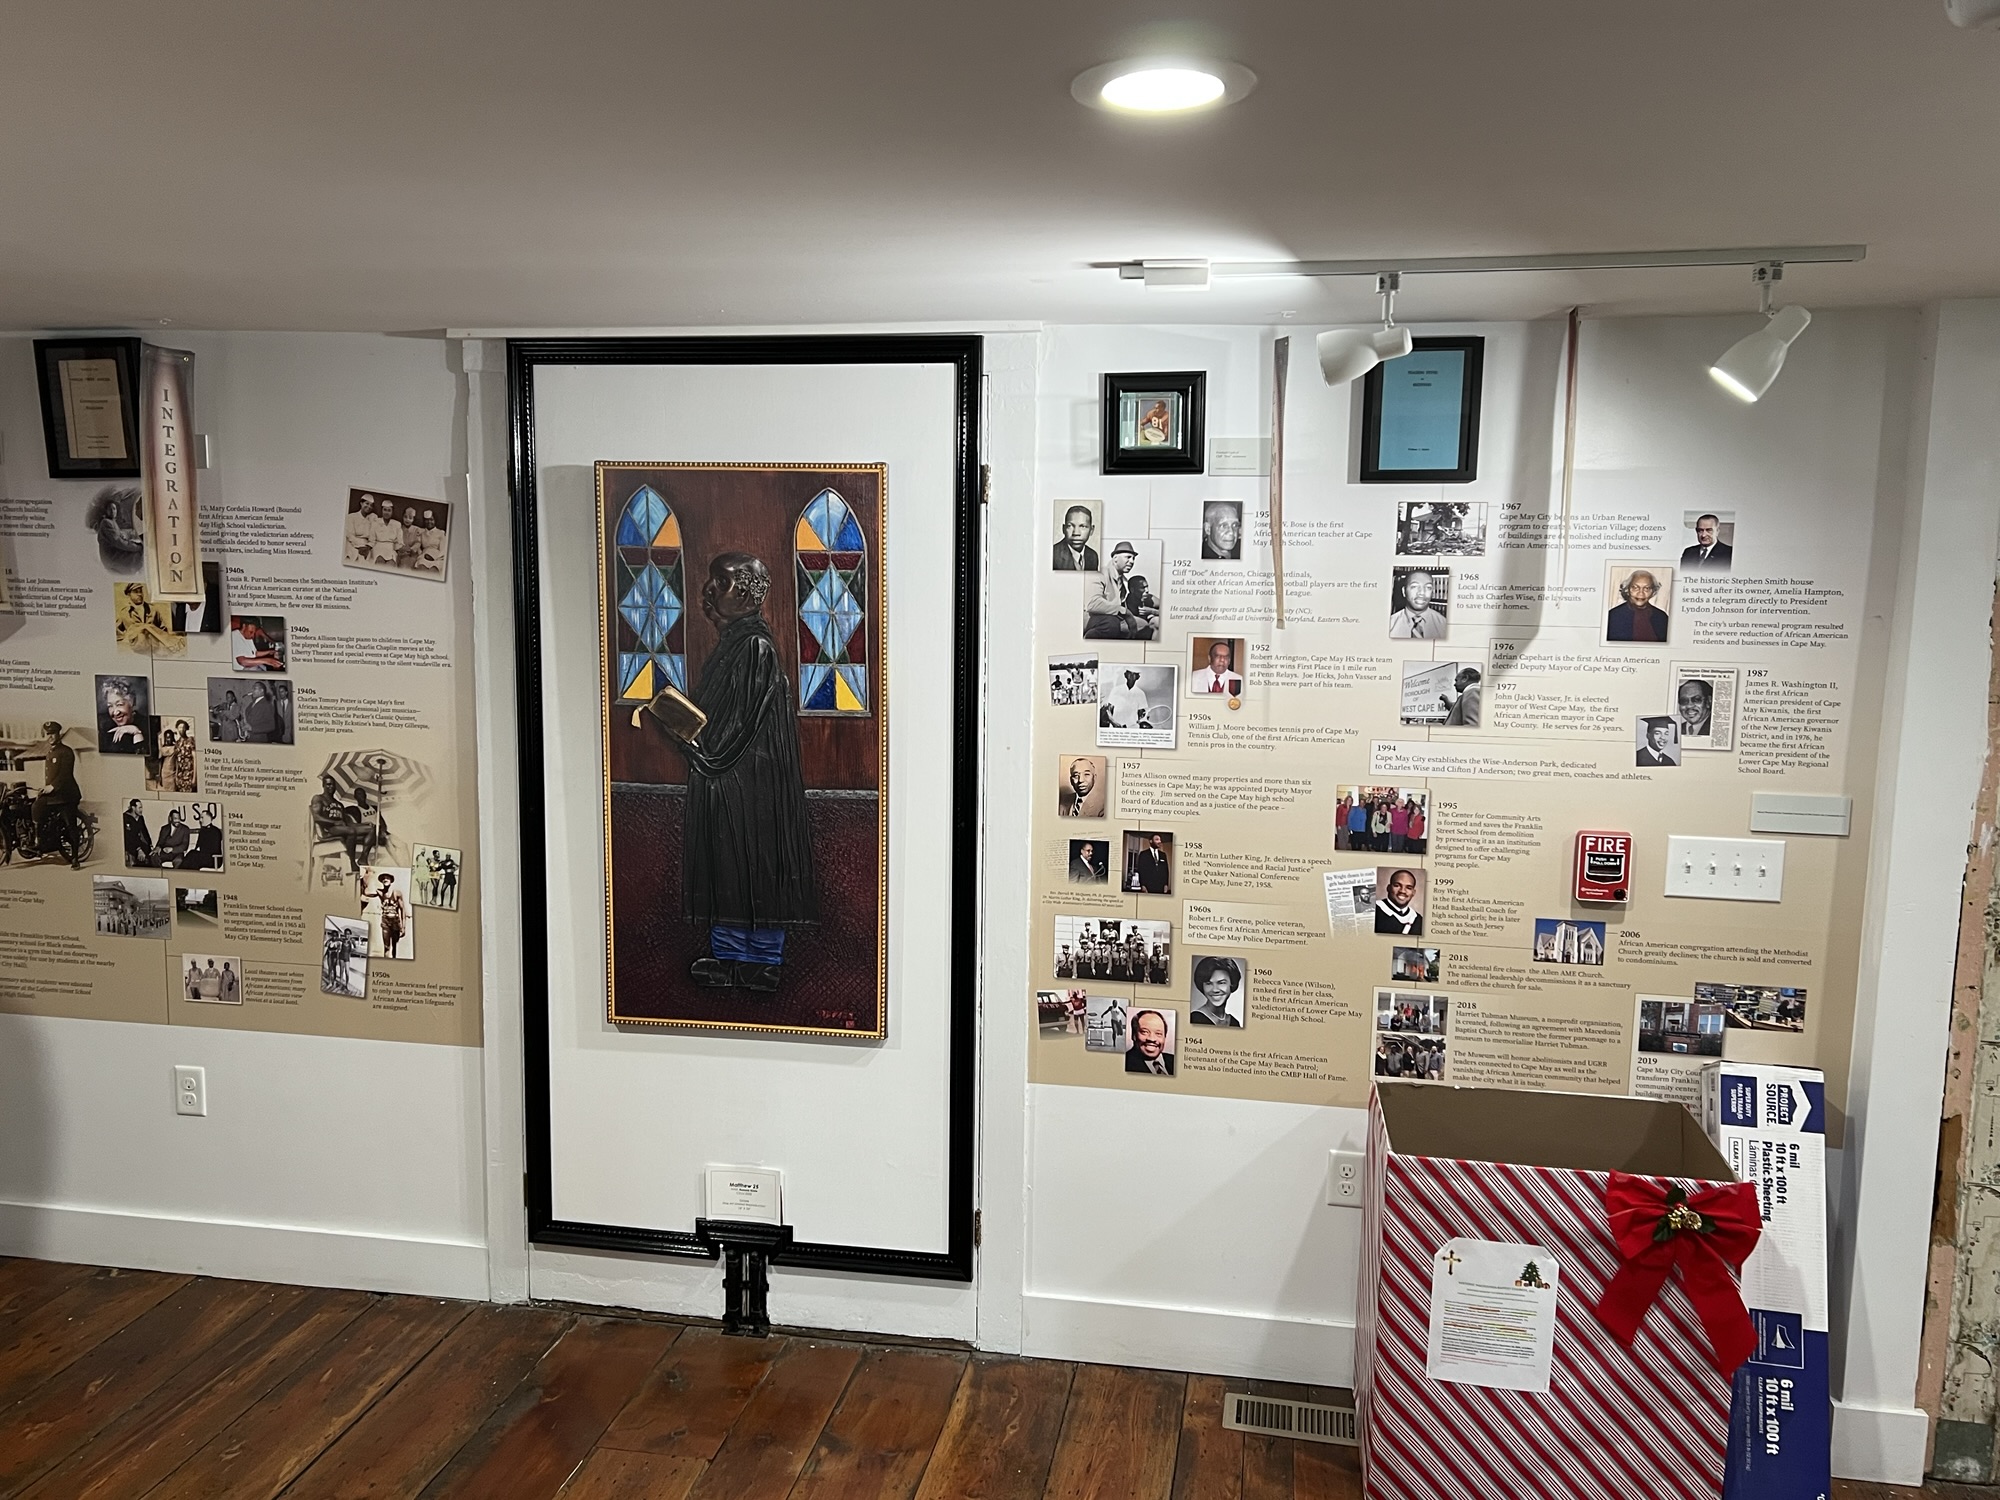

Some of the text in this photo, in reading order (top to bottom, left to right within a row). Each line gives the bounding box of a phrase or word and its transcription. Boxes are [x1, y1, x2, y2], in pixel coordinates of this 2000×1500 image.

[1151, 416, 1163, 430] 81
[161, 388, 184, 583] INTEGRATION
[1502, 502, 1522, 510] 1967
[1173, 559, 1191, 567] 1952
[225, 566, 244, 574] 1940s
[1700, 576, 1729, 584] historic
[1731, 577, 1763, 586] Stephen
[1764, 577, 1788, 585] Smith
[1789, 577, 1814, 585] house
[1734, 586, 1743, 594] its
[1804, 587, 1845, 597] Hampton,
[1682, 595, 1703, 603] sends
[1712, 595, 1746, 605] telegram
[1748, 596, 1778, 606] directly
[1789, 597, 1828, 605] President
[290, 625, 309, 633] 1940s
[1495, 642, 1514, 650] 1976
[1250, 652, 1272, 660] Robert
[1274, 653, 1309, 663] Arrington,
[1310, 654, 1327, 663] Cape
[1329, 654, 1343, 663] May
[1375, 655, 1392, 663] team
[1747, 669, 1768, 677] 1987
[1404, 678, 1430, 689] Welcome
[1496, 682, 1516, 690] 1977
[1746, 679, 1768, 687] James
[1781, 680, 1827, 690] Washington
[1829, 681, 1839, 690] II,
[1404, 688, 1430, 697] BOROUGH
[1417, 704, 1434, 712] CAPE
[204, 747, 222, 755] 1940s
[1375, 753, 1598, 768] Cape May City establishes the Wise-Anderson Park, dedicated
[1438, 801, 1457, 809] 1995
[1437, 810, 1541, 822] The Center for Community Arts
[1185, 841, 1202, 849] 1958
[1585, 837, 1627, 853] FIRE
[1183, 850, 1193, 858] Dr.
[1195, 851, 1218, 859] Martin
[1220, 852, 1242, 860] Luther
[1244, 853, 1262, 863] King,
[1273, 854, 1300, 863] delivers
[1307, 856, 1331, 866] speech
[223, 893, 237, 901] 1948
[1189, 905, 1211, 913] 1960s
[1620, 930, 1640, 938] 2006
[1619, 940, 1809, 956] African American congregation attending the Methodist
[1448, 953, 1468, 961] 2018
[371, 970, 390, 978] 1950s
[1254, 968, 1272, 976] 1960
[1457, 1001, 1476, 1009] 2018
[1456, 1009, 1479, 1018] Harriet
[1481, 1011, 1508, 1020] Tubman
[1509, 1013, 1540, 1022] Museum,
[1546, 1015, 1578, 1026] nonprofit
[1579, 1017, 1624, 1029] organization,
[1185, 1036, 1202, 1044] 1964
[1637, 1056, 1657, 1064] 2019
[1779, 1086, 1789, 1123] PROJECT
[1776, 1142, 1786, 1153] 10
[1749, 1140, 1759, 1177] Láminas
[1776, 1156, 1787, 1164] ft
[1789, 1152, 1800, 1168] mil
[1760, 1141, 1774, 1222] Plastic Sheeting
[1776, 1175, 1787, 1193] 100
[1776, 1195, 1787, 1204] ft
[1781, 1379, 1794, 1411] 6 mil
[1766, 1377, 1779, 1455] 10 ft x 100 ft
